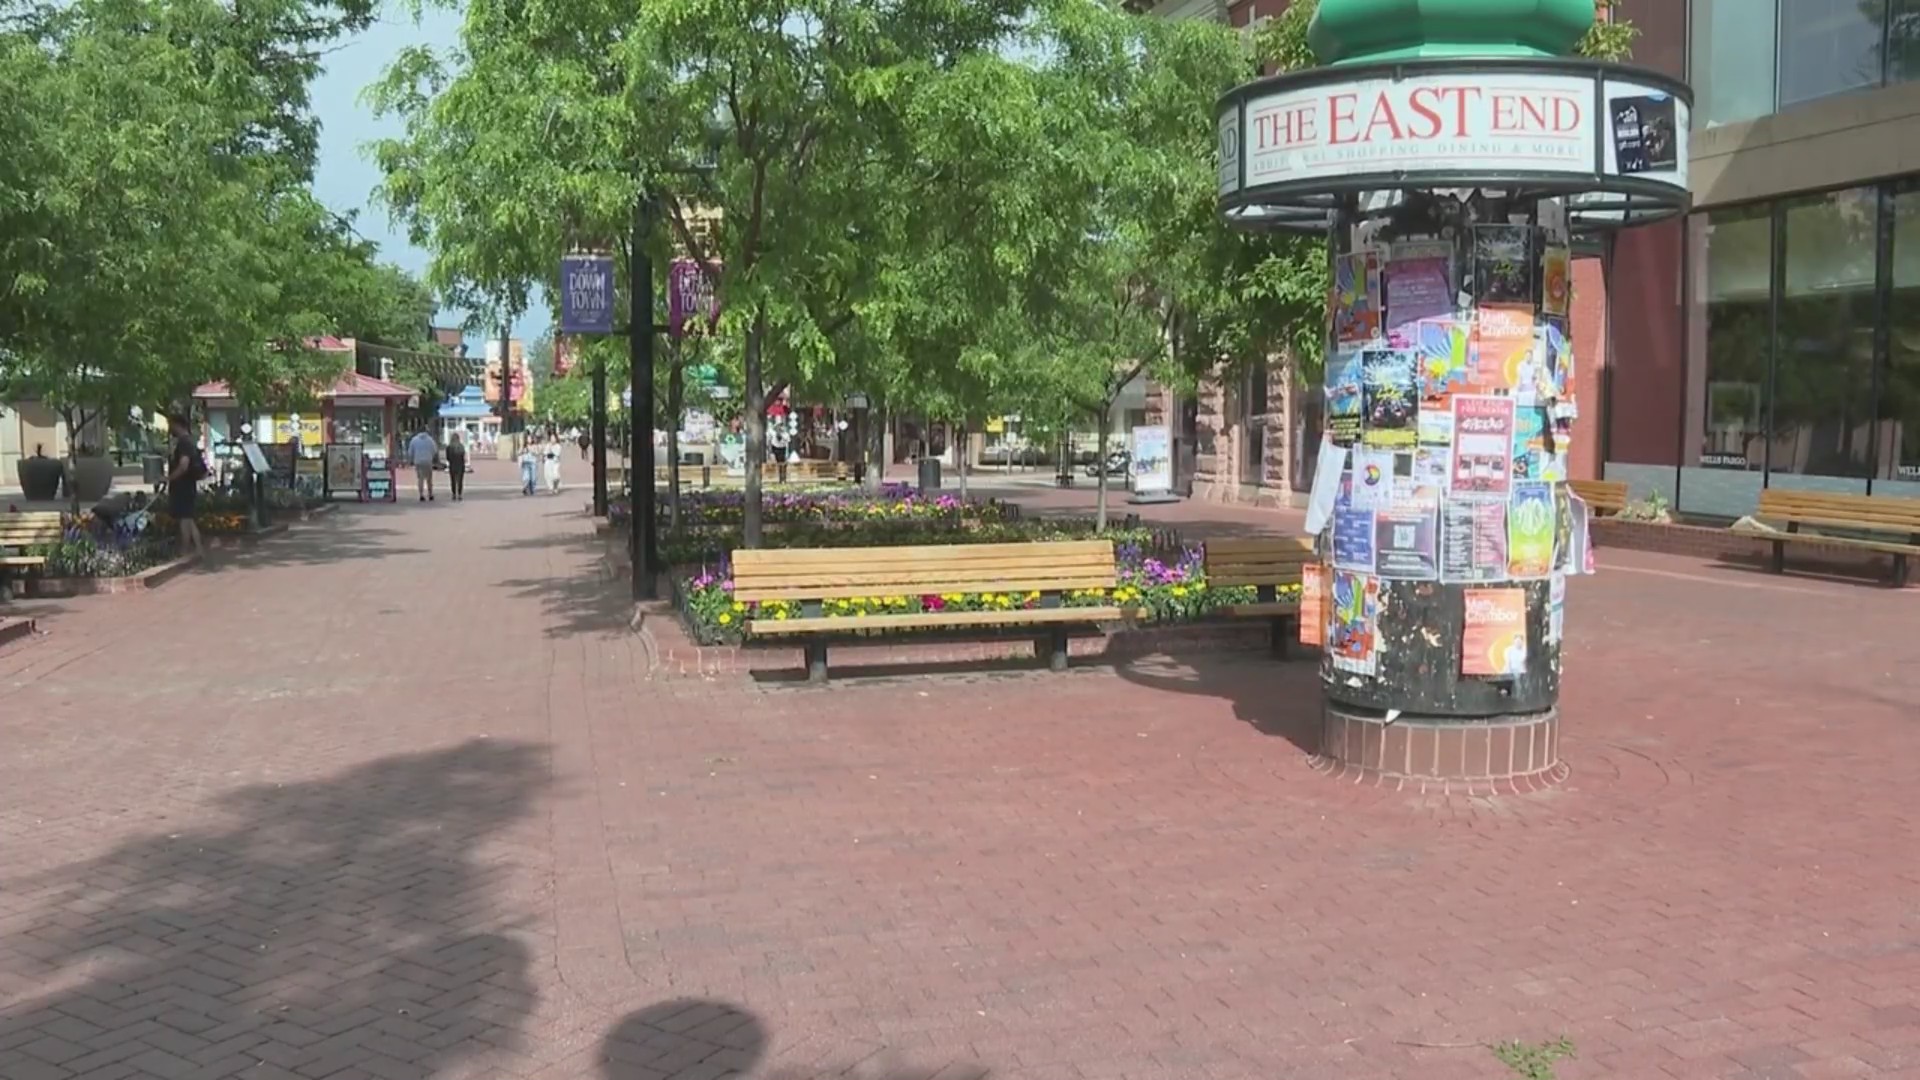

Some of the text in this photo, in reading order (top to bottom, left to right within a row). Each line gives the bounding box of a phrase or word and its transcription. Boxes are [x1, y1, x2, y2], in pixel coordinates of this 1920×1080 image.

[1253, 86, 1581, 149] THE EAST END
[1437, 141, 1502, 154] DINING
[569, 272, 606, 291] DOWN
[570, 290, 606, 310] TOWN
